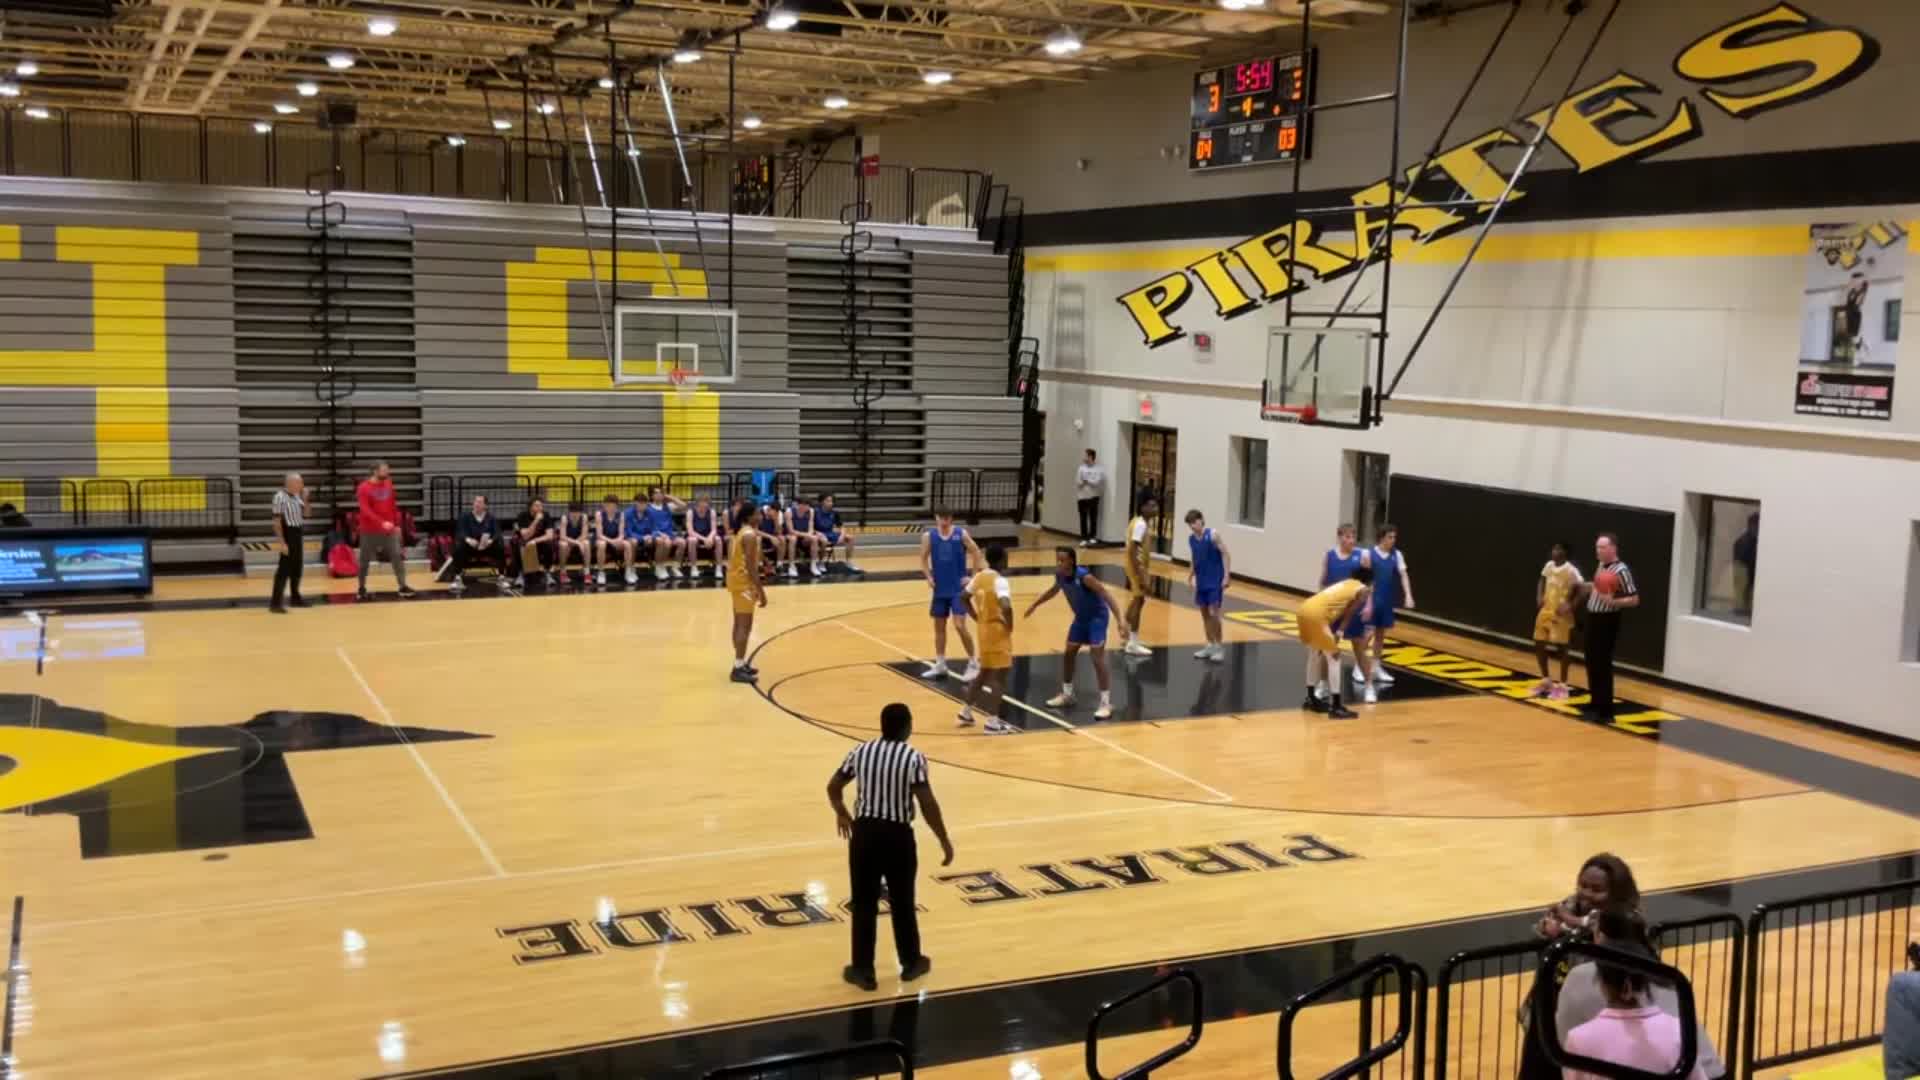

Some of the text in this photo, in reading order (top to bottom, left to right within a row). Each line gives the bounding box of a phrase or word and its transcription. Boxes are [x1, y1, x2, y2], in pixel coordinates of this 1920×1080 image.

[1236, 60, 1272, 92] 5:54
[1208, 84, 1220, 113] 3
[1196, 139, 1213, 160] 04
[1278, 127, 1298, 150] 03
[1117, 3, 1880, 348] PIRATES
[930, 832, 1368, 906] PIRATE
[496, 890, 929, 966] RIDE
